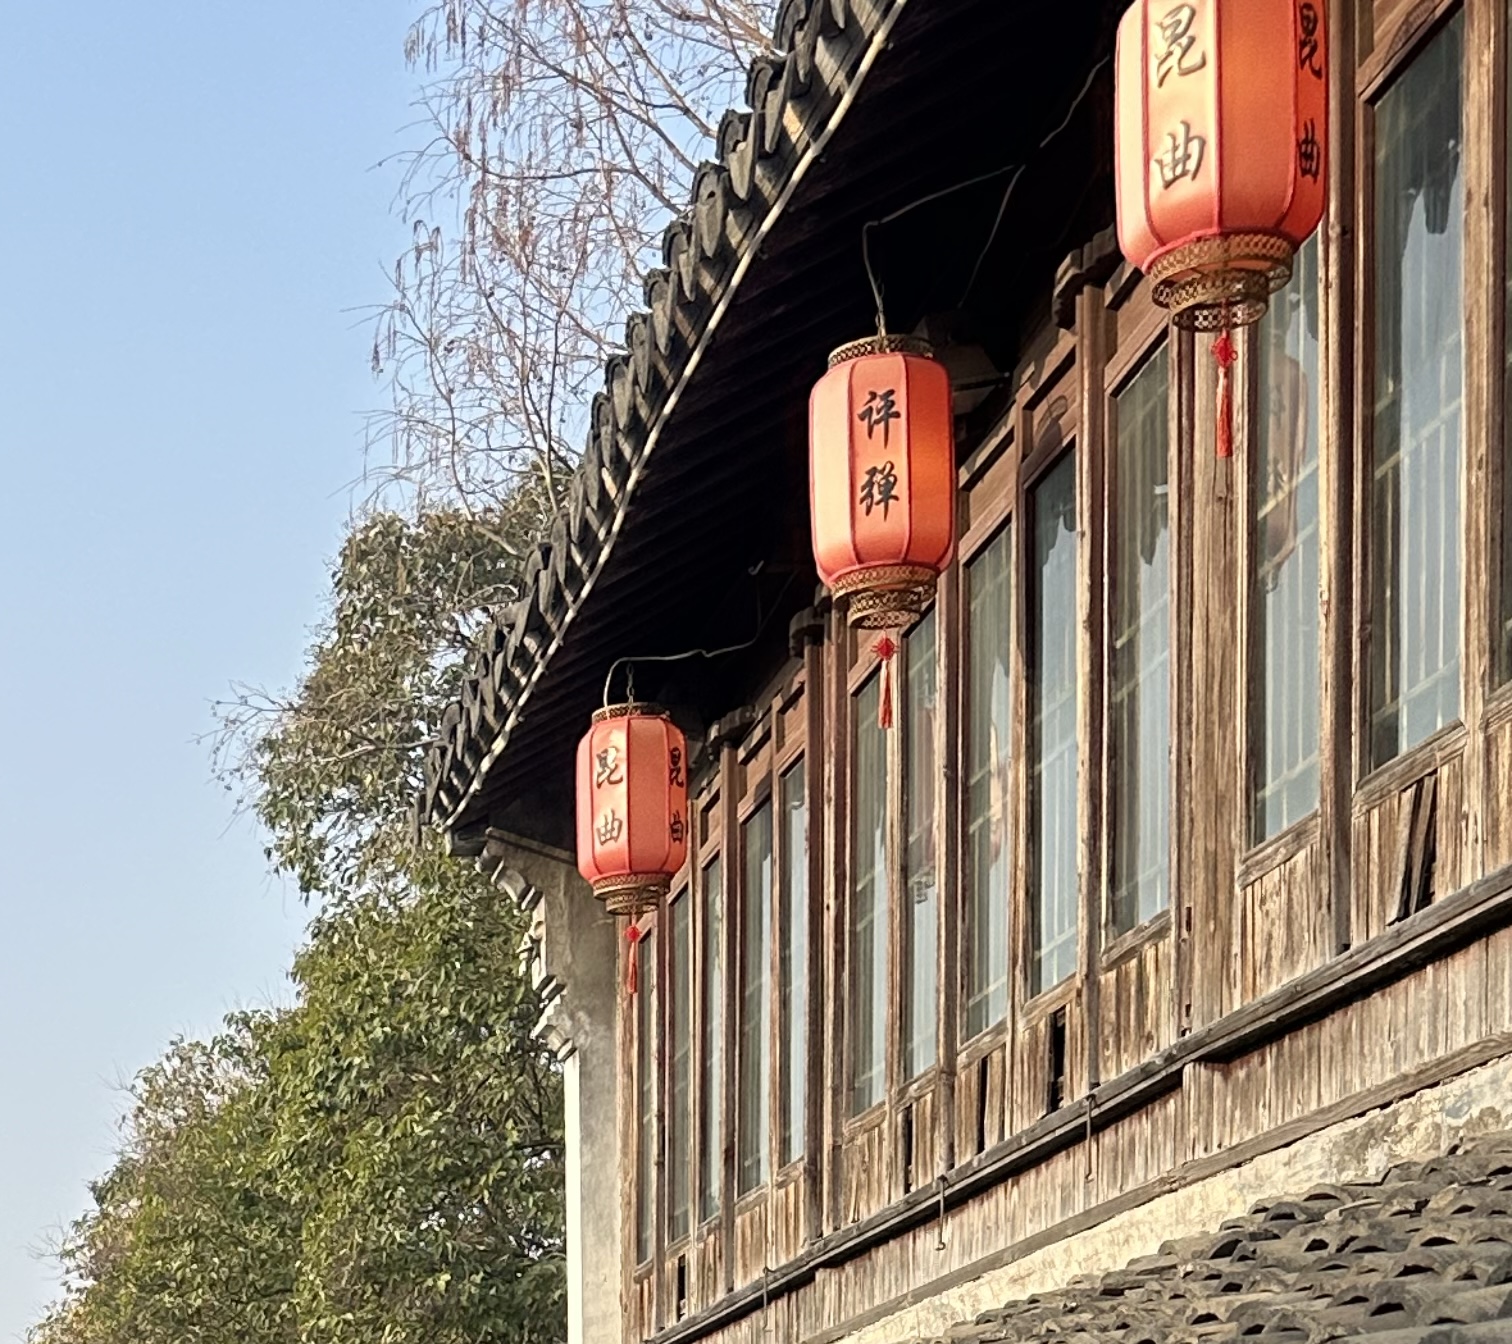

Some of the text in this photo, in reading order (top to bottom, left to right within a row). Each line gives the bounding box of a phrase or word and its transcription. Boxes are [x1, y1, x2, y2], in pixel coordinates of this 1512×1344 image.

[1154, 3, 1207, 190] 昆曲
[1298, 3, 1323, 184] 昆曲
[595, 745, 624, 846] 昆曲
